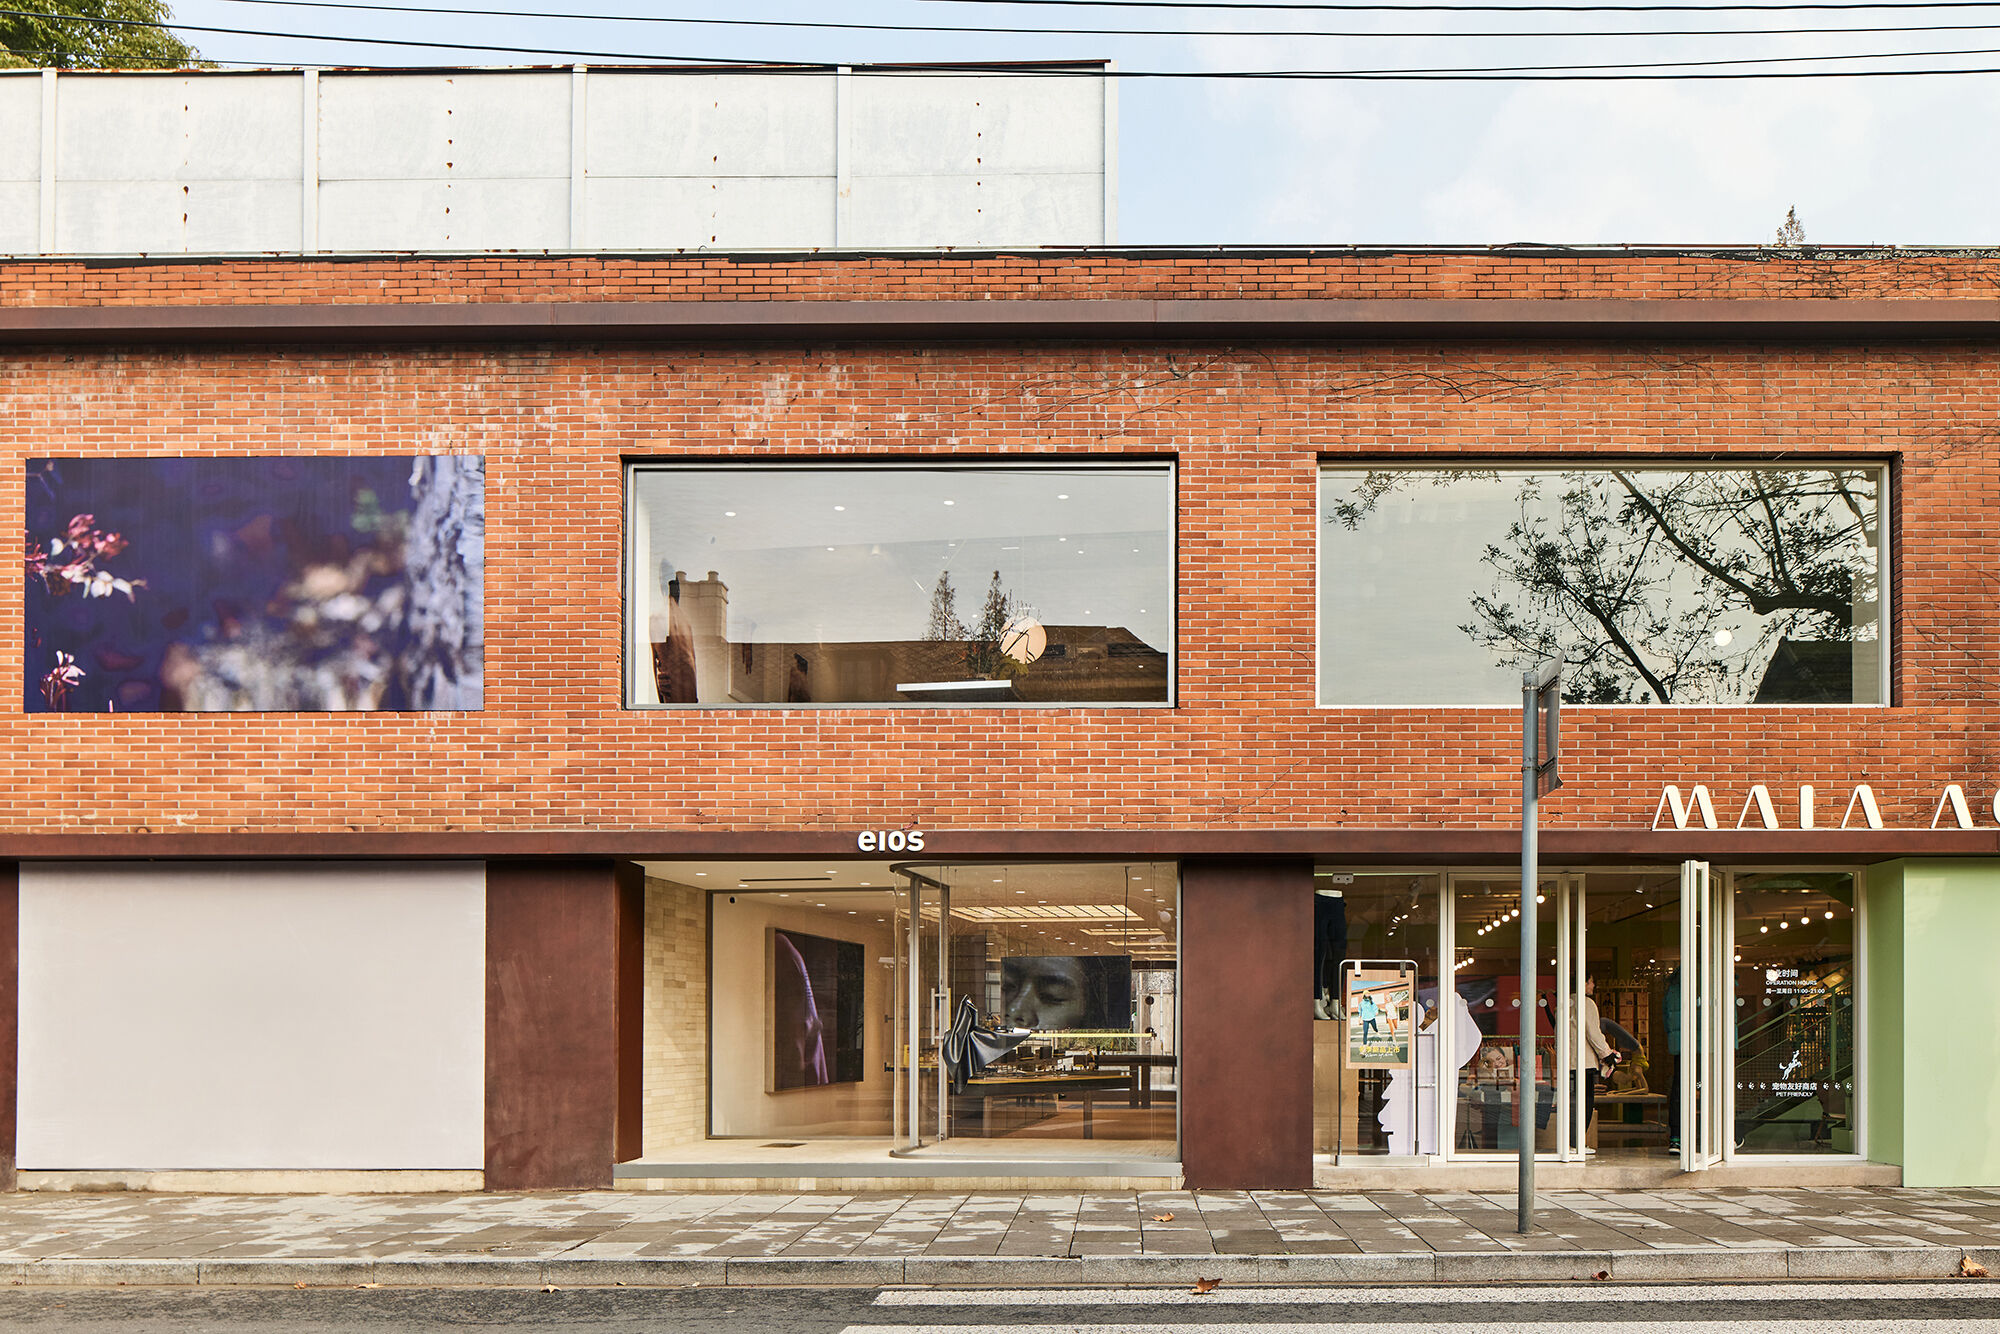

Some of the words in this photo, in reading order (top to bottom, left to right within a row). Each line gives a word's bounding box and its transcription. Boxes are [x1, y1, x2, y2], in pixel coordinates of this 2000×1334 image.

[1651, 784, 1884, 830] MAIA
[1930, 784, 2000, 830] A
[1766, 969, 1798, 977] 业时间
[1772, 1082, 1817, 1090] 宠物友好商店
